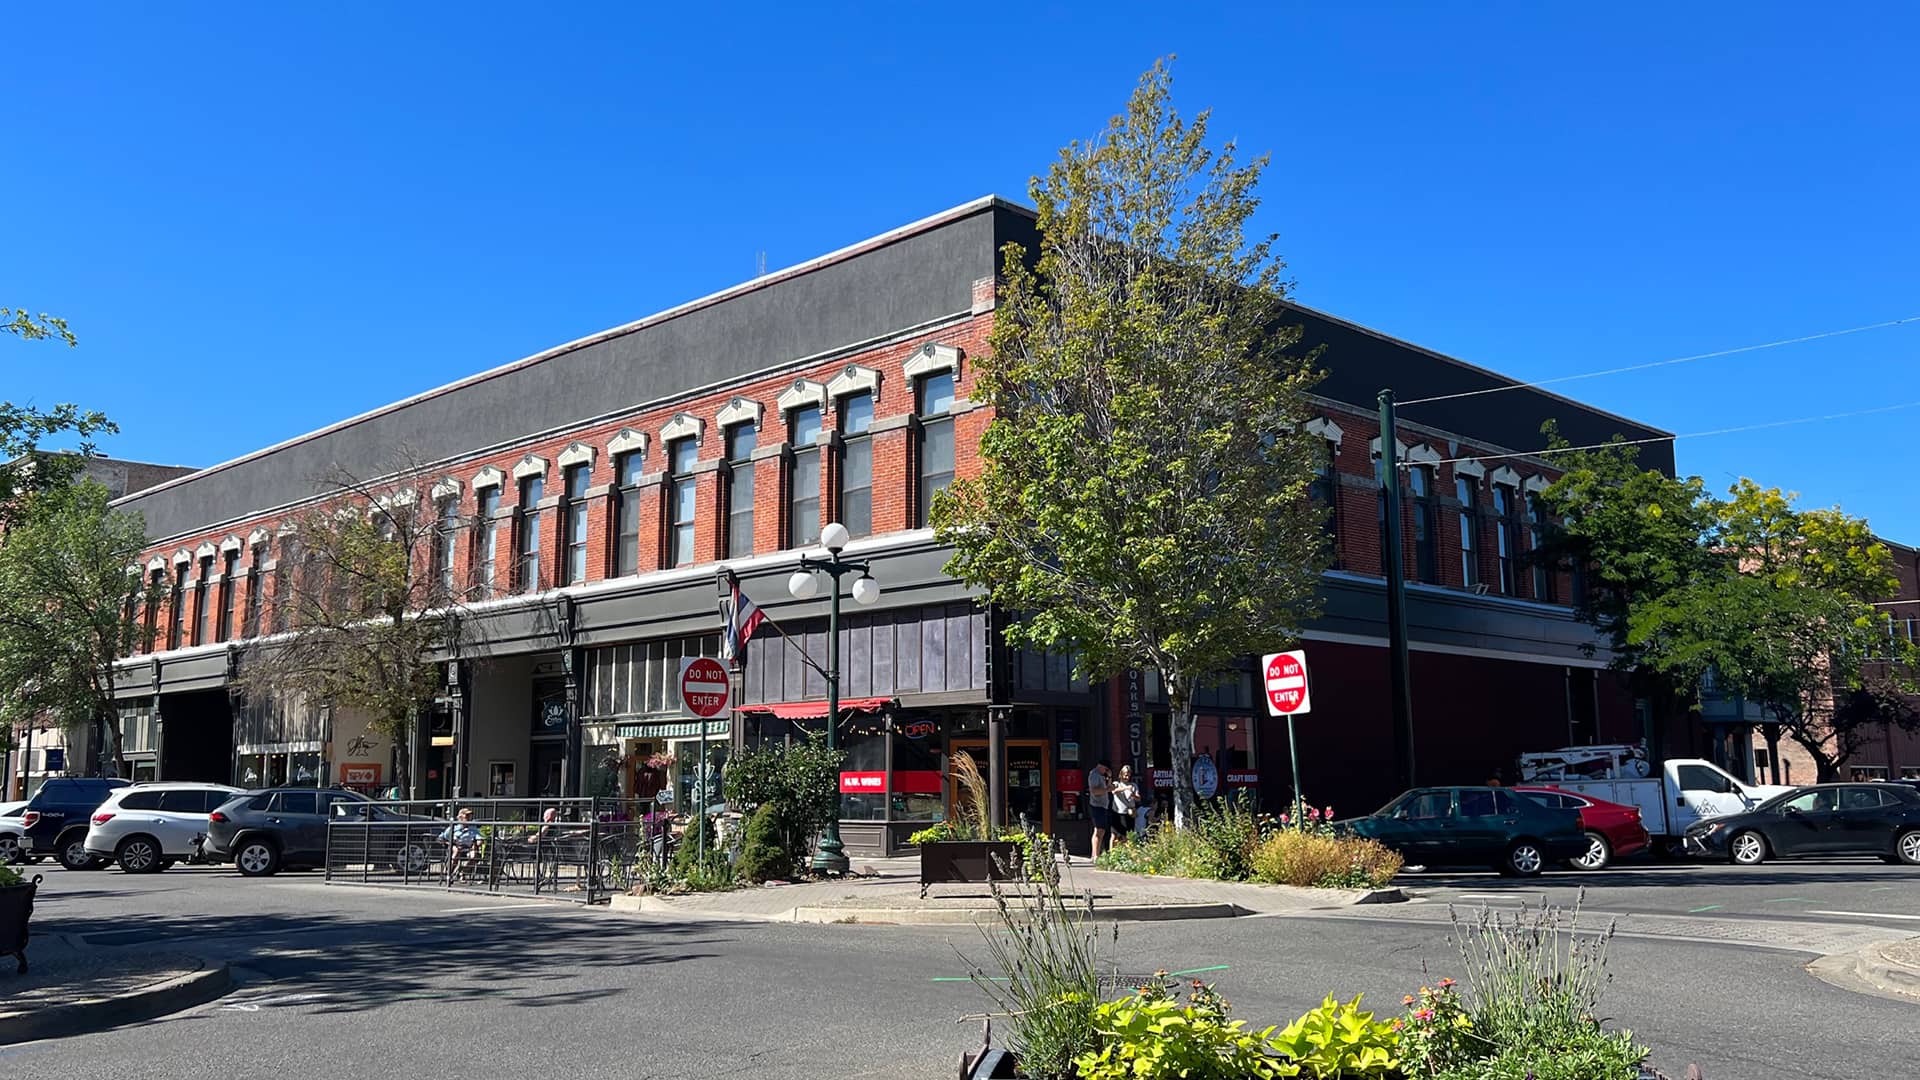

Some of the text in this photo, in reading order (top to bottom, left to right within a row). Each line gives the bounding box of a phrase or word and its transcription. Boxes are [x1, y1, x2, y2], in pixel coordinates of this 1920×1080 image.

[689, 669, 723, 680] DO NOT
[1269, 663, 1299, 677] DO NOT
[692, 696, 719, 706] ENTER
[1274, 691, 1299, 703] ENTER
[905, 723, 934, 735] OPEN
[1226, 774, 1243, 782] CRAFT
